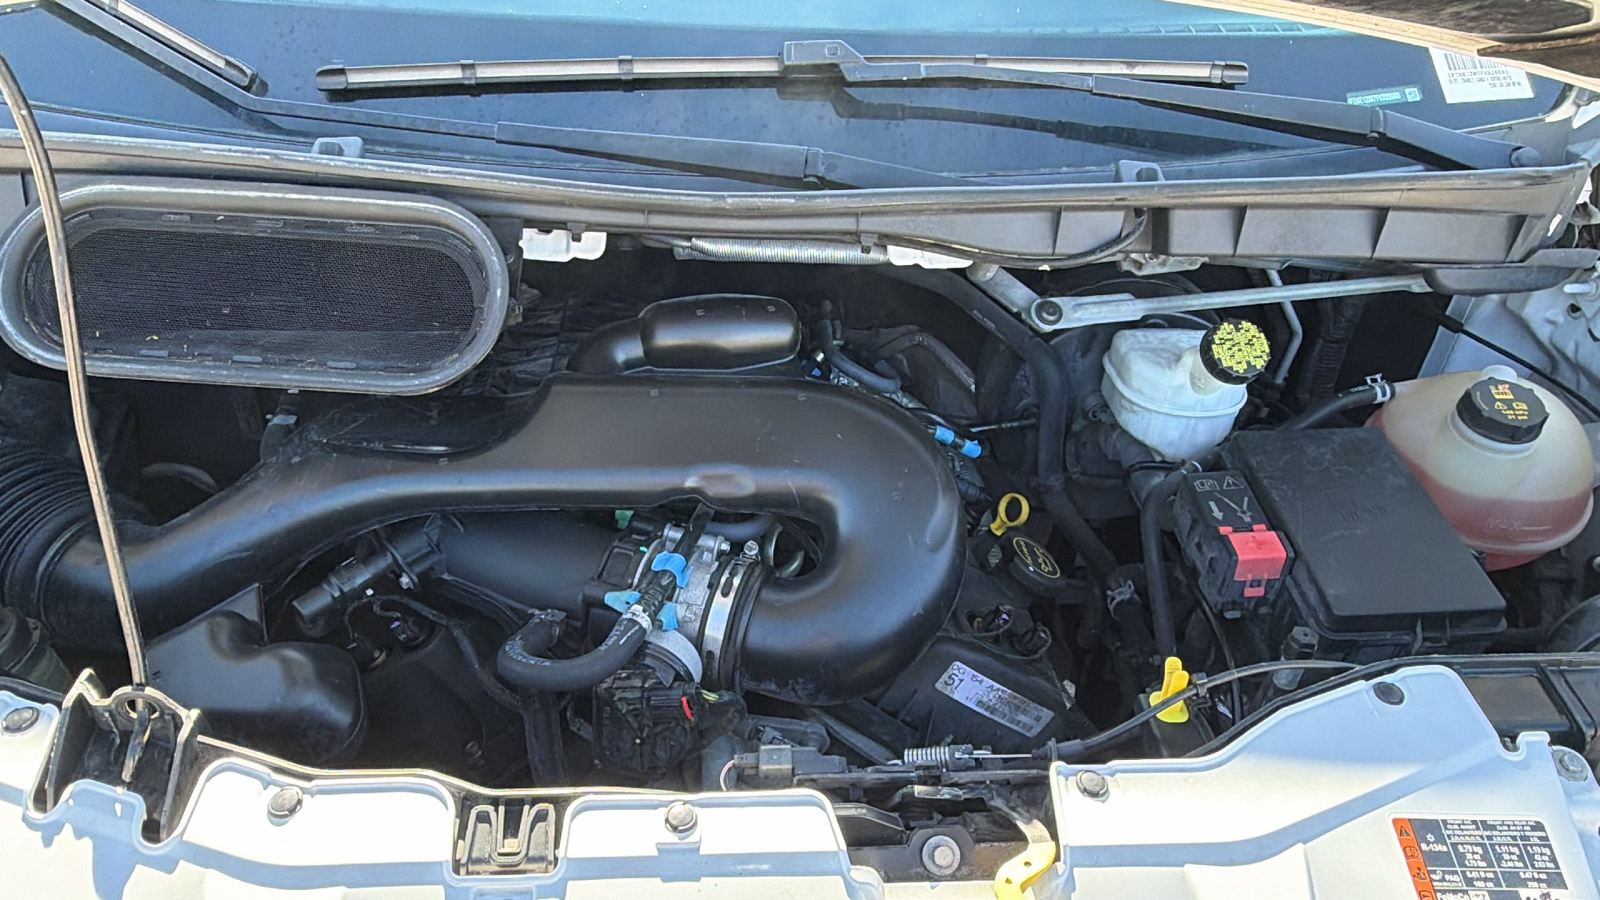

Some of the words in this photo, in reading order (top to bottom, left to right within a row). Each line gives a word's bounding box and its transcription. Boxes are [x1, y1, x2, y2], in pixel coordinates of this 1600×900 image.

[952, 663, 966, 675] DG
[944, 672, 965, 690] 51
[1420, 842, 1448, 852] R-134a
[1457, 844, 1473, 852] 0.79
[1472, 844, 1483, 854] kg
[1494, 845, 1509, 853] 1.11
[1509, 845, 1520, 855] kg
[1527, 846, 1541, 854] 1.19
[1541, 846, 1551, 856] kg
[1444, 874, 1460, 882] PAG
[1436, 892, 1470, 900] FoMoCo
